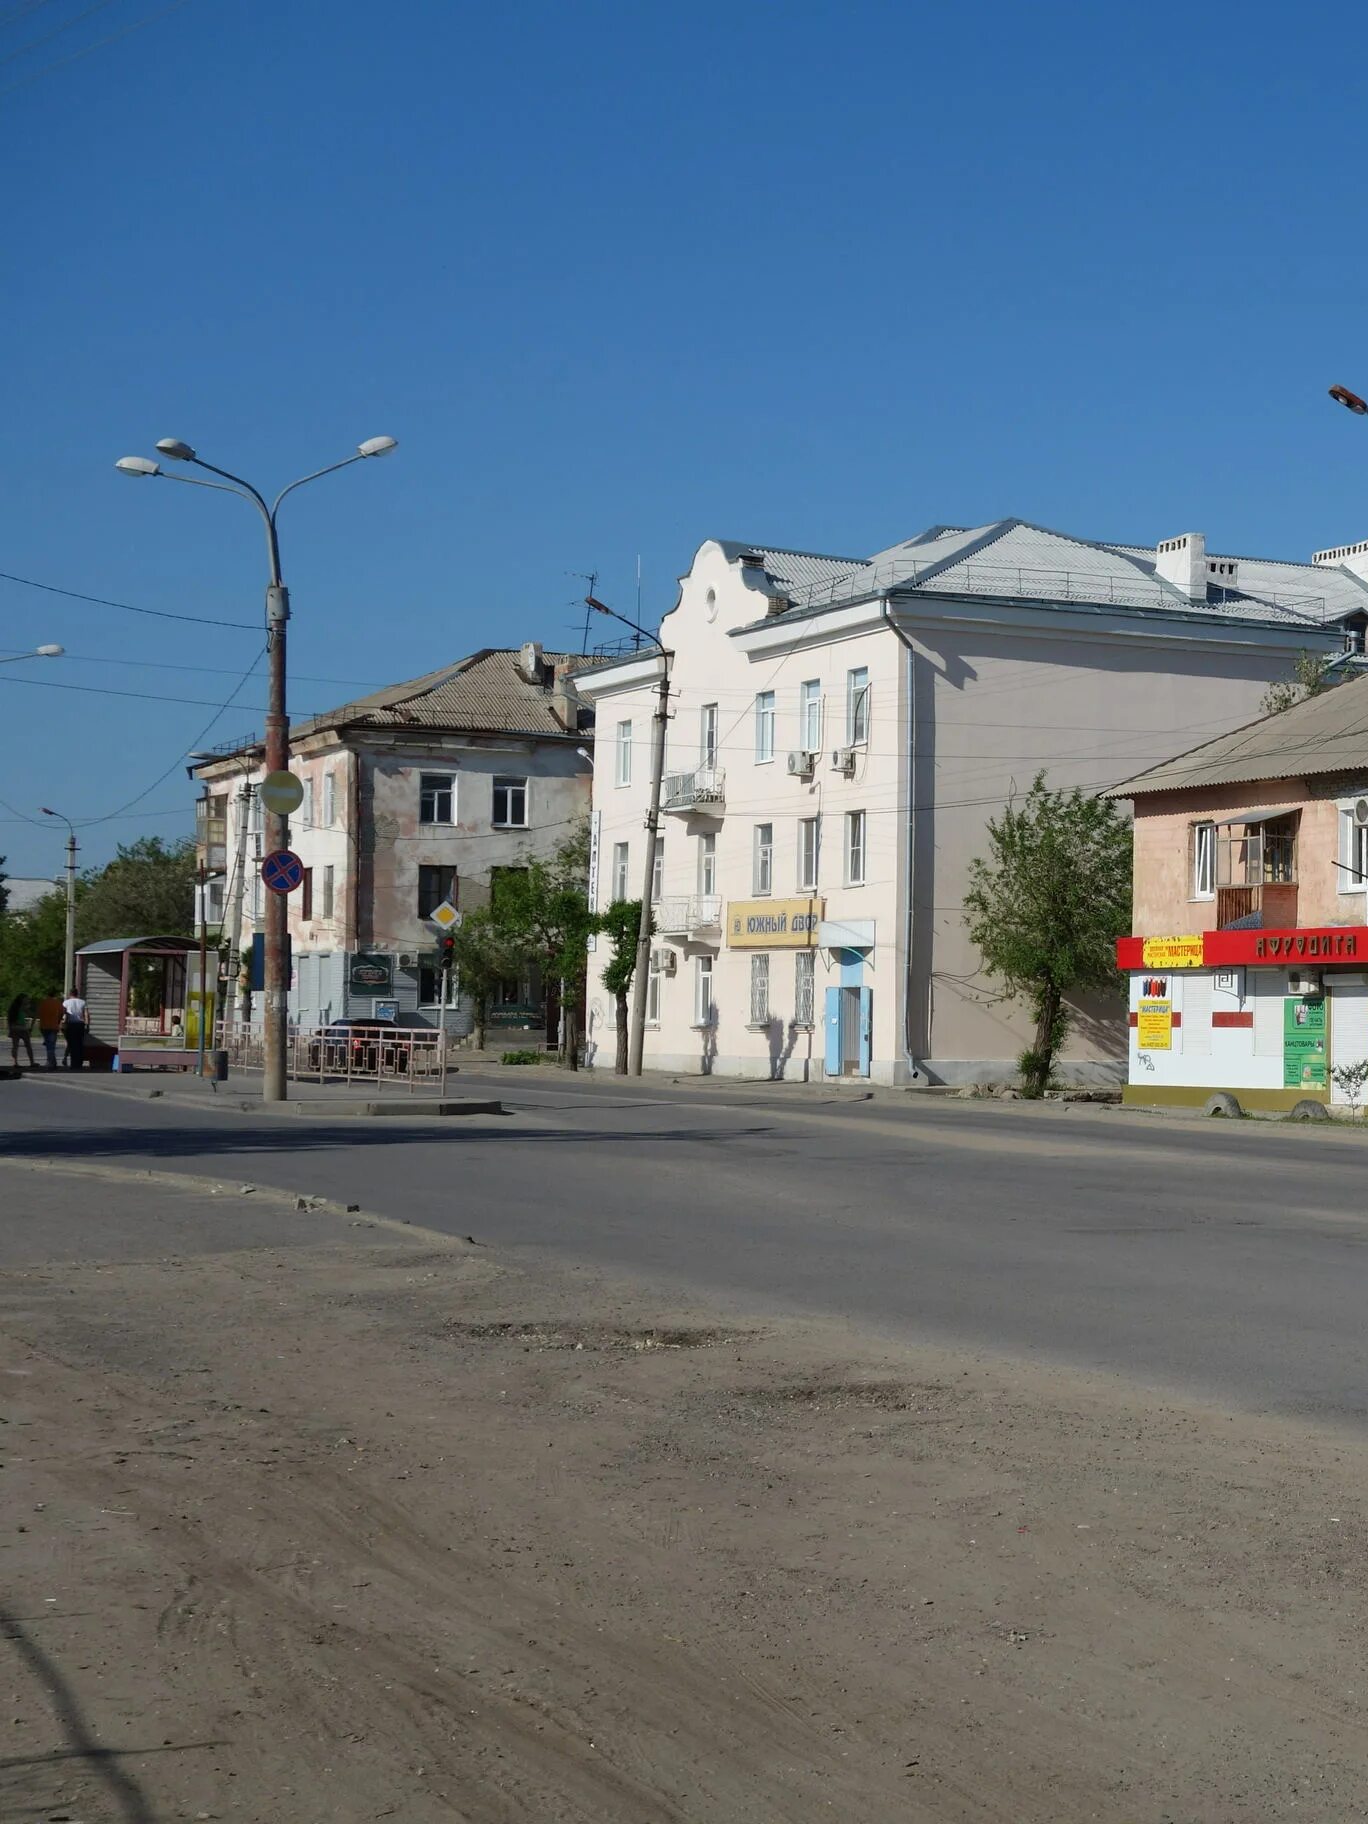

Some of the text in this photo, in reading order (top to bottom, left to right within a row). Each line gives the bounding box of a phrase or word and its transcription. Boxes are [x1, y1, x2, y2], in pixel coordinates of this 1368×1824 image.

[747, 913, 818, 934] ЮЖНЫЙ ДВОР
[1256, 935, 1355, 957] АФРОДИТА
[1308, 1003, 1324, 1011] ФОТО
[1285, 1040, 1315, 1048] КАНЦТОВАРЫ
